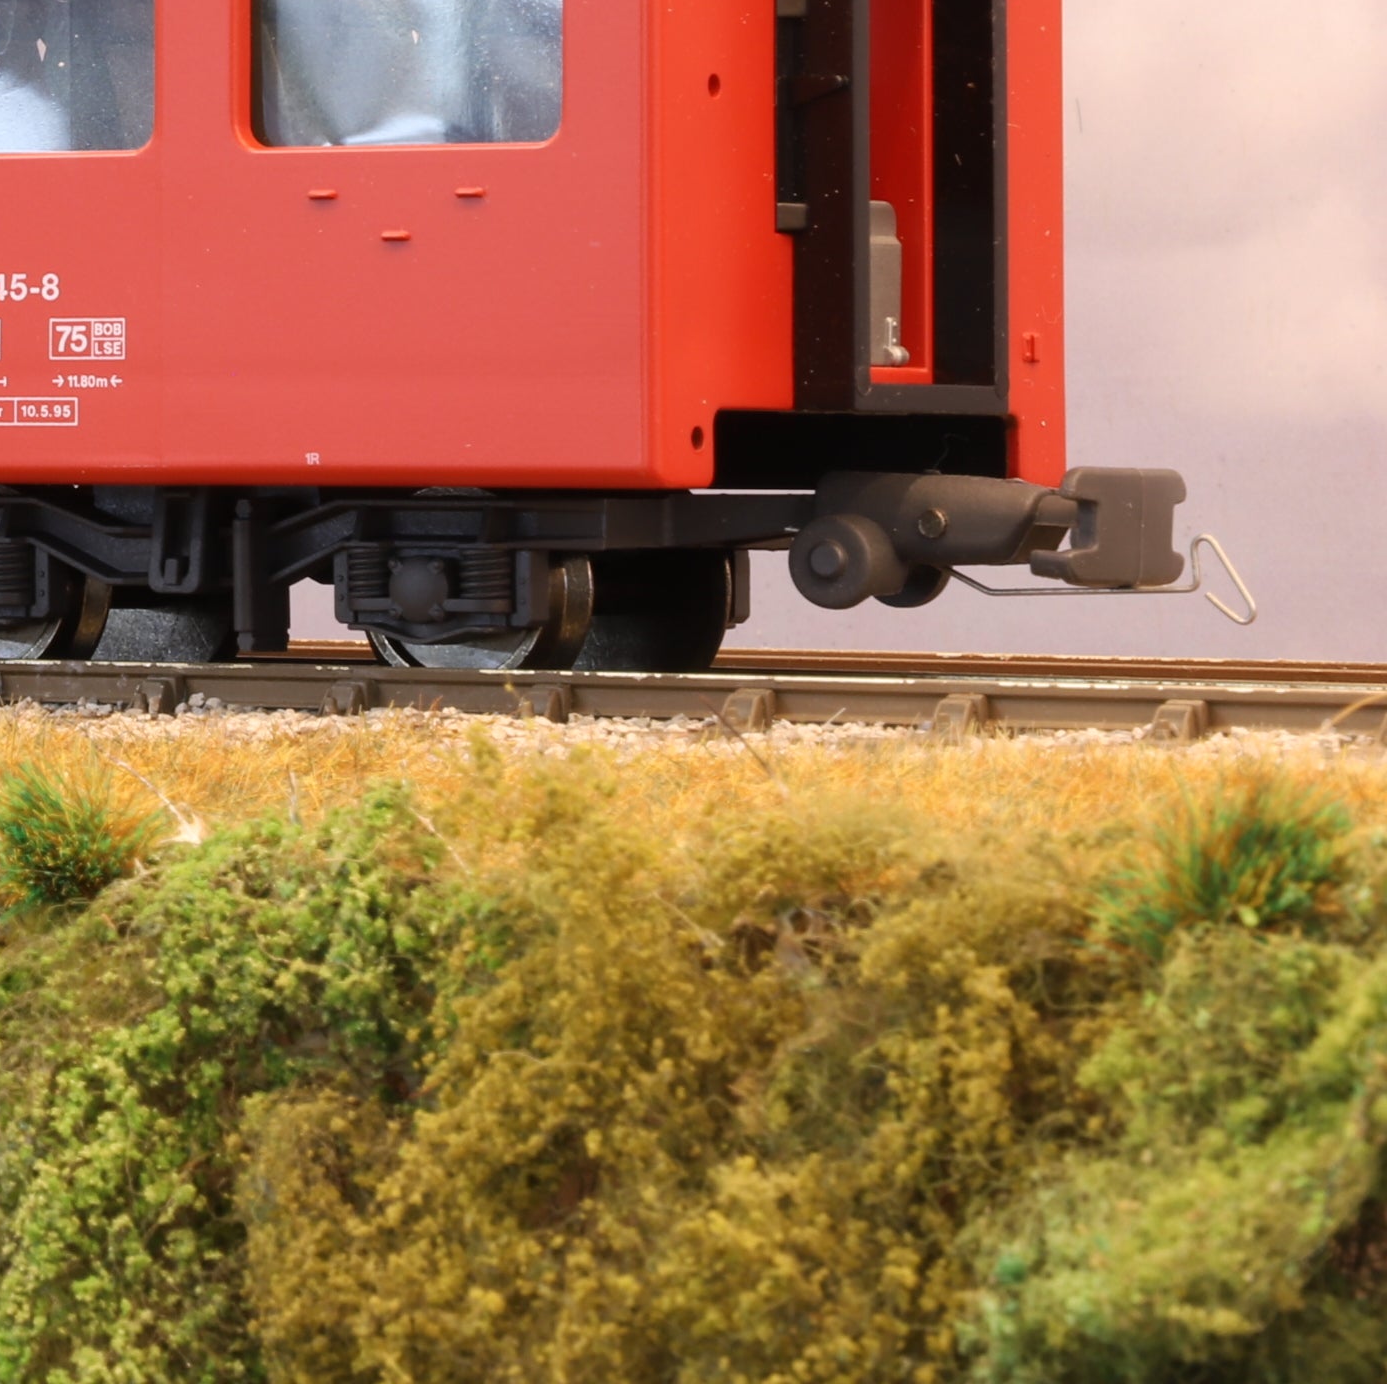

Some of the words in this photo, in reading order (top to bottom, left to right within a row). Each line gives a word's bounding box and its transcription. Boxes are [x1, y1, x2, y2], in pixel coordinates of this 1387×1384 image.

[93, 322, 123, 336] BOB
[55, 325, 88, 353] 75
[93, 341, 123, 355] LSE
[305, 452, 320, 465] 1R
